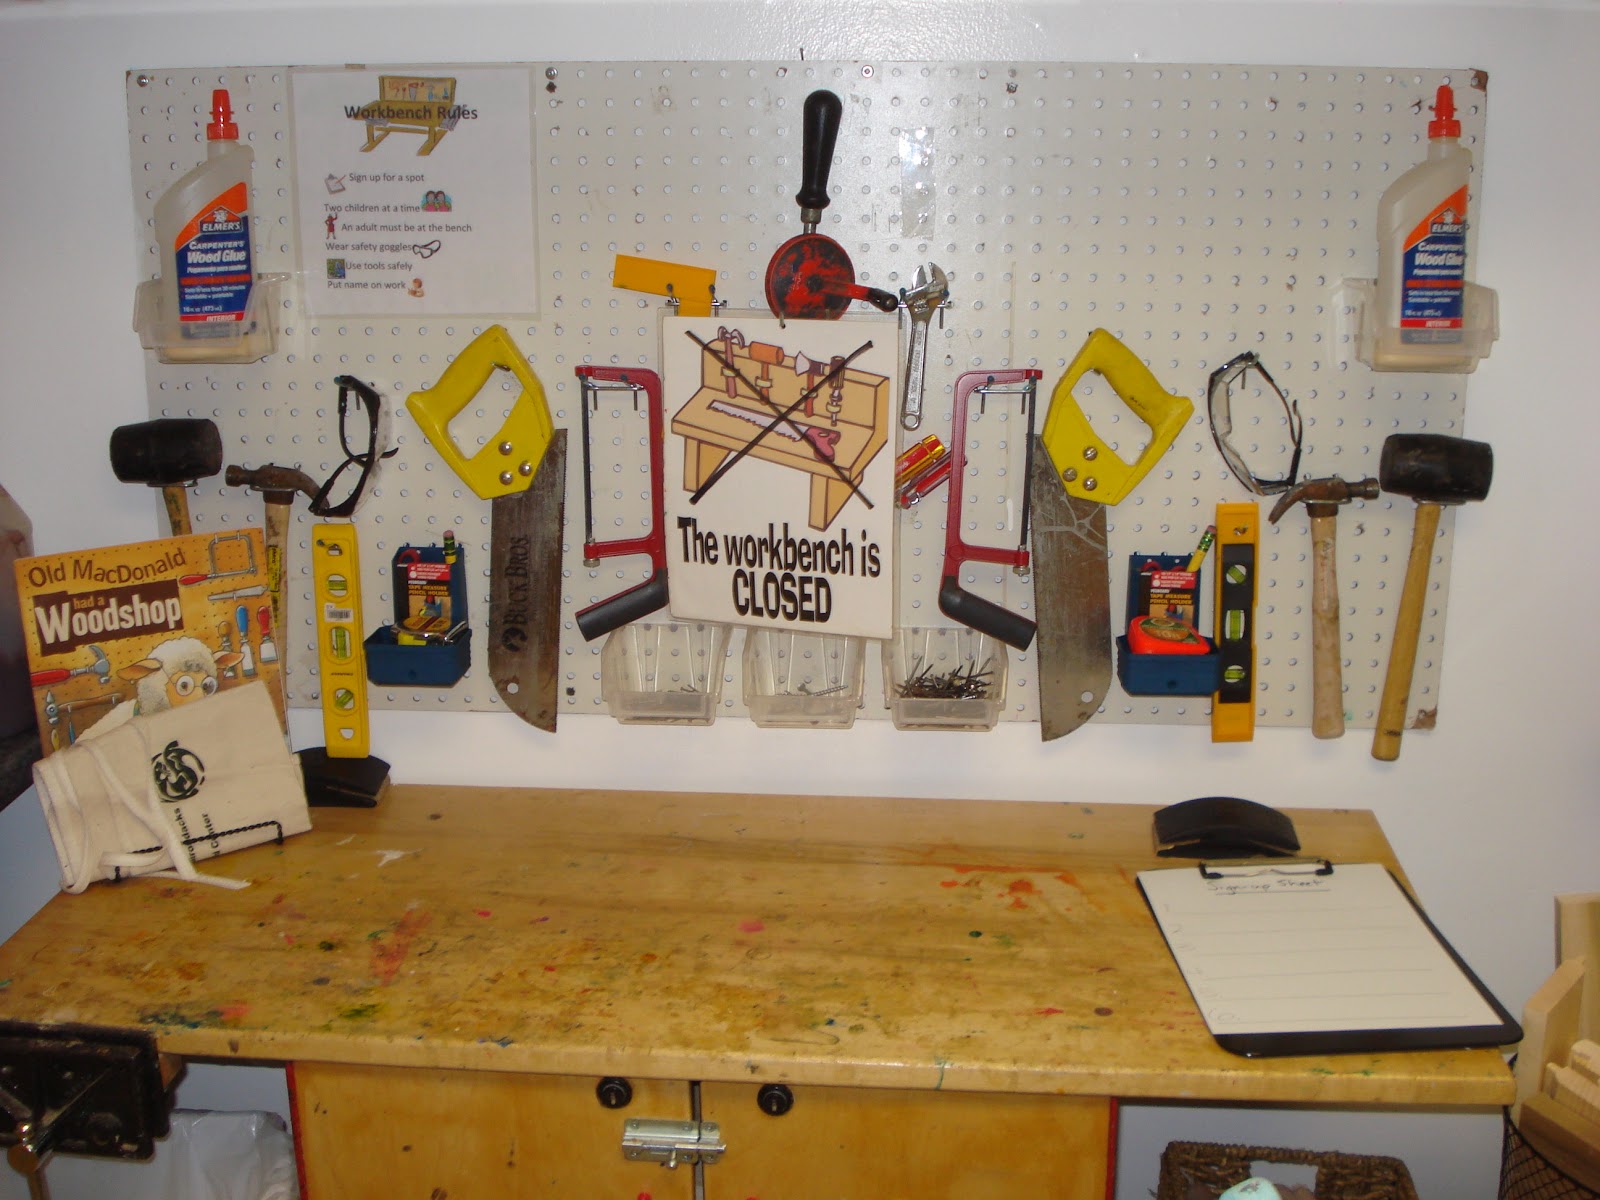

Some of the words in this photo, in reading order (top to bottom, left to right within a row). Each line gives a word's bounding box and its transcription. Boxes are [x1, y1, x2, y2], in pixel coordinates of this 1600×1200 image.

[344, 105, 432, 119] Workbench
[438, 105, 478, 120] Rules
[349, 173, 367, 183] Sign
[370, 175, 381, 183] up
[383, 173, 395, 182] for
[405, 174, 425, 183] spot
[324, 204, 342, 213] Two
[345, 203, 379, 213] children
[382, 205, 391, 213] at
[401, 204, 420, 213] time
[202, 222, 241, 232] ELMER'S
[341, 224, 353, 232] An
[355, 223, 378, 232] adult
[380, 224, 401, 232] must
[404, 223, 414, 232] be
[417, 224, 426, 232] at
[428, 223, 443, 232] the
[445, 223, 472, 232] bench
[325, 242, 349, 251] Wear
[351, 242, 378, 253] safety
[379, 243, 413, 253] goggles
[187, 250, 222, 264] Wood
[222, 249, 246, 262] Glue
[1414, 253, 1446, 266] Wood
[345, 262, 361, 270] Use
[364, 262, 386, 270] tools
[387, 262, 413, 272] safely
[327, 281, 342, 289] Put
[384, 281, 406, 289] work
[206, 314, 237, 322] INTERIOR
[677, 515, 719, 566] The
[723, 522, 854, 577] workbench
[860, 528, 881, 578] is
[28, 561, 66, 588] Old
[73, 547, 186, 584] MacDonald
[732, 568, 832, 623] CLOSED
[73, 596, 94, 609] had
[97, 596, 105, 606] a
[503, 582, 528, 625] BUCK
[35, 594, 182, 645] Woodshop
[202, 813, 219, 849] Cnter
